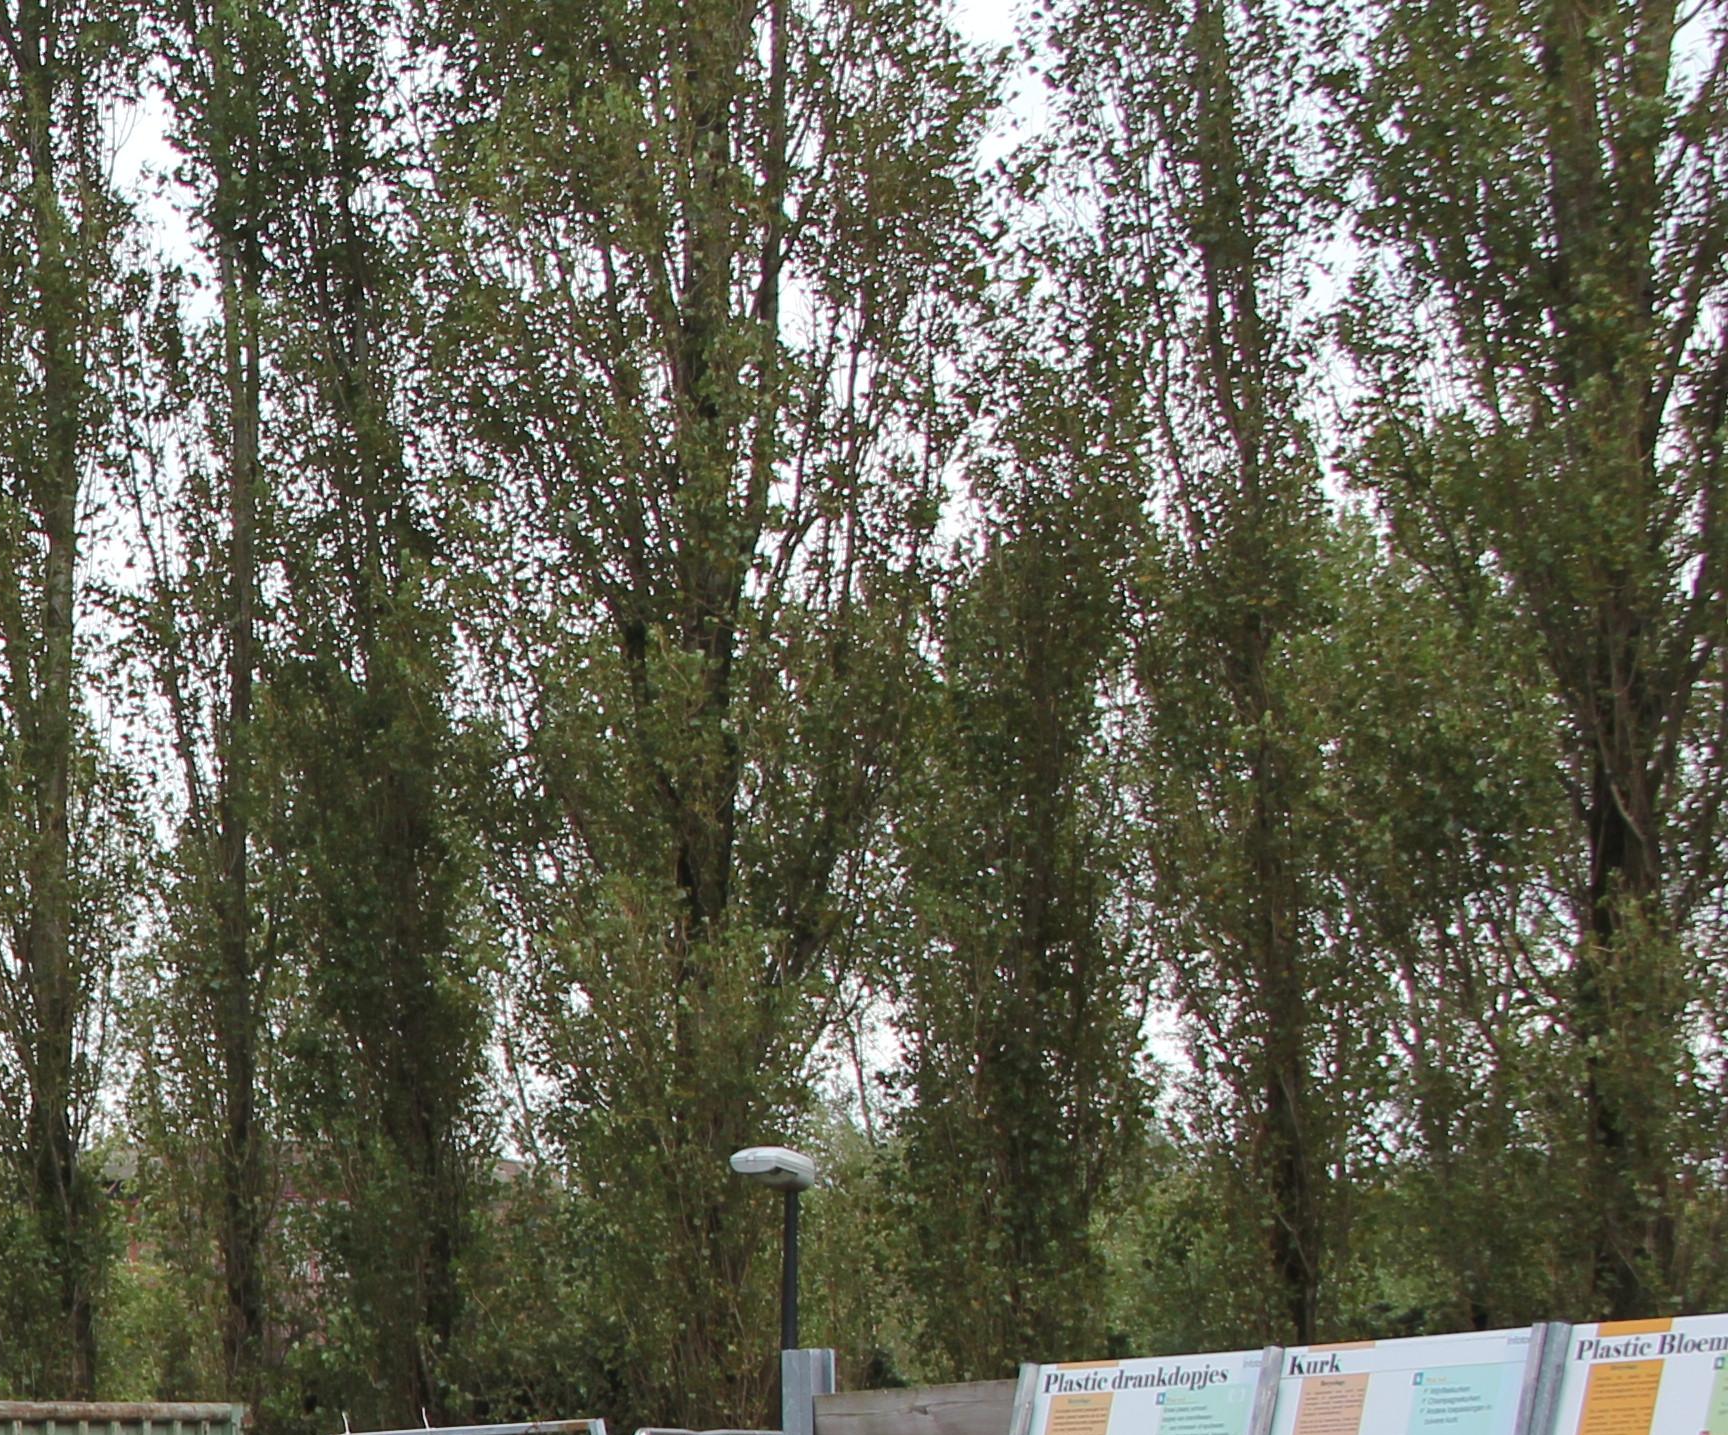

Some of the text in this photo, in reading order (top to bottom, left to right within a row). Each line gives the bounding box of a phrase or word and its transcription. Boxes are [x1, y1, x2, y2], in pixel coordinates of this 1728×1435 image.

[1575, 1336, 1652, 1360] Plastic
[1289, 1353, 1341, 1375] Kurk
[1043, 1364, 1229, 1393] Plastic drankdopjes
